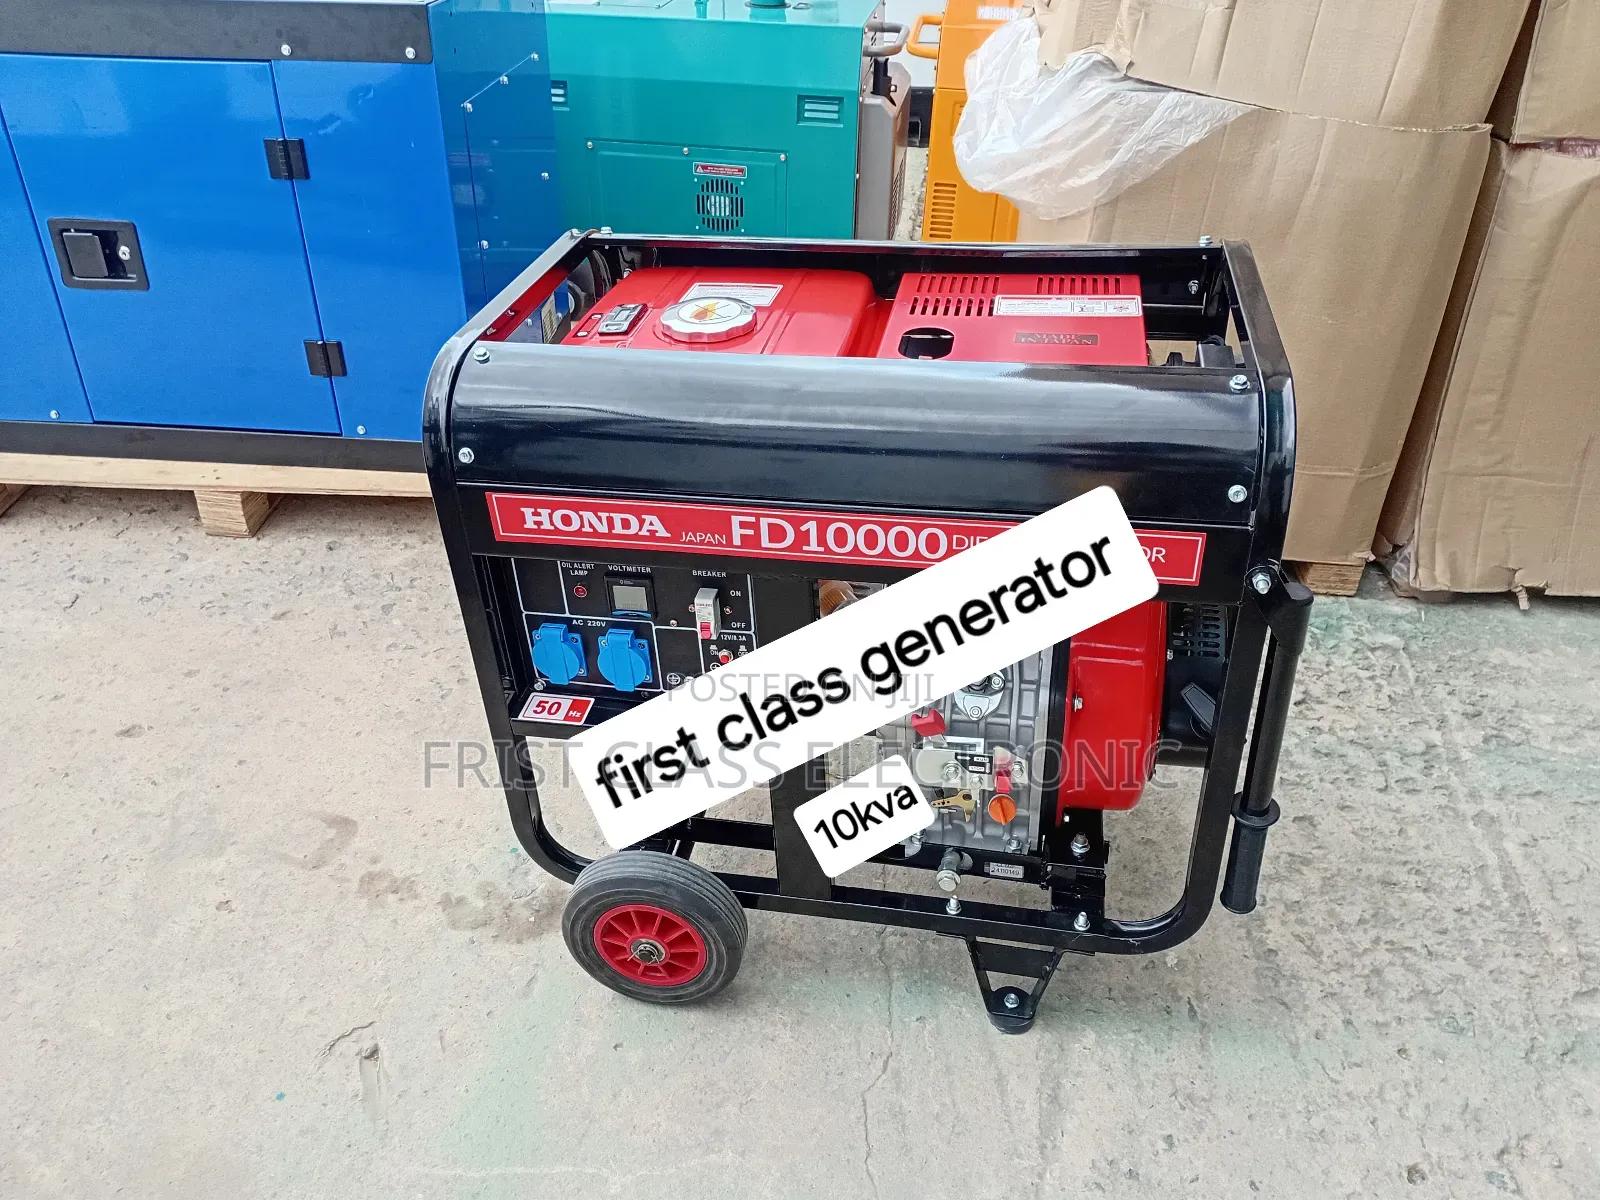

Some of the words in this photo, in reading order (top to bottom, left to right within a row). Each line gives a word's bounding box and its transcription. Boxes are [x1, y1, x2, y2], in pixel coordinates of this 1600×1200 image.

[520, 507, 671, 538] HONDA
[679, 531, 727, 545] JAPAN
[730, 514, 948, 560] FD10000
[607, 565, 652, 573] VOLTMETER
[692, 570, 727, 578] BREAKER
[532, 700, 562, 717] 50
[568, 710, 582, 718] Hz
